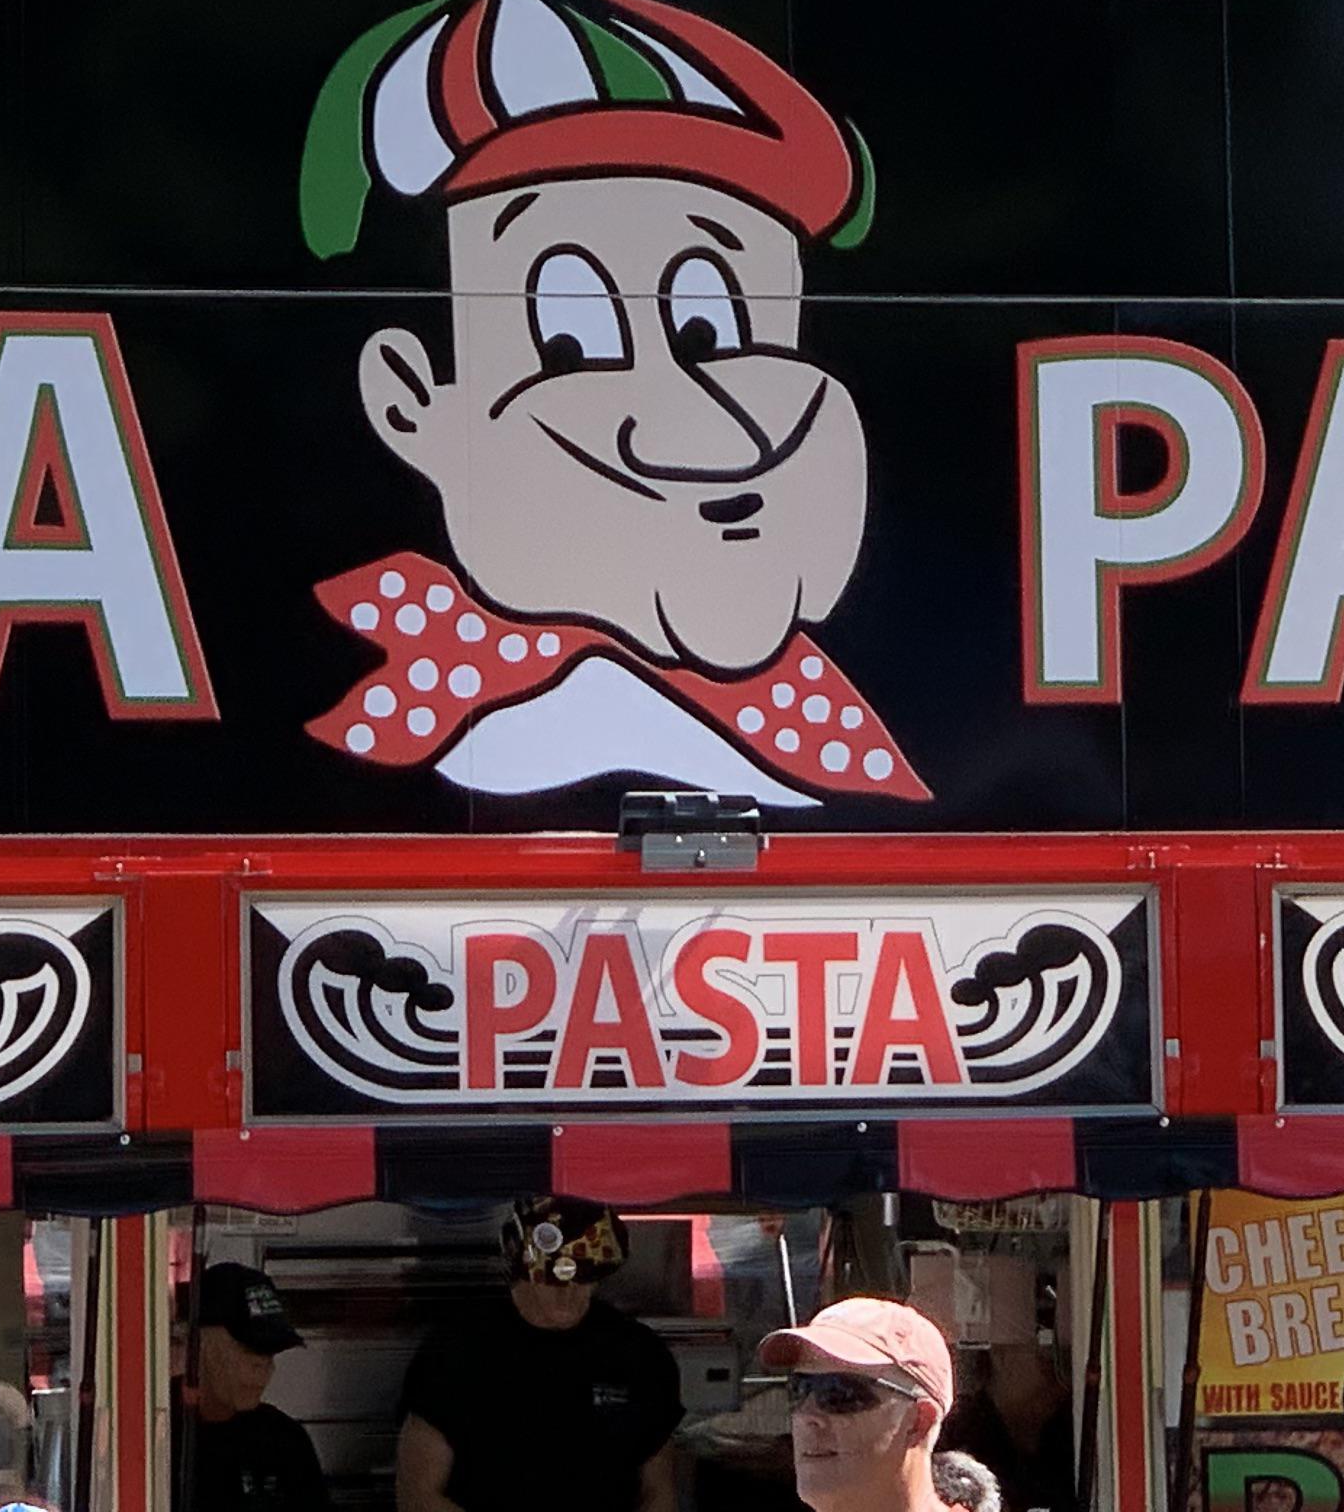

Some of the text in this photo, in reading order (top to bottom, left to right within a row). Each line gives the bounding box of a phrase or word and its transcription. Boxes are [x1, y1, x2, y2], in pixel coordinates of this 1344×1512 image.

[460, 928, 970, 1088] PASTA
[1204, 1381, 1340, 1413] WITH SAUCE
